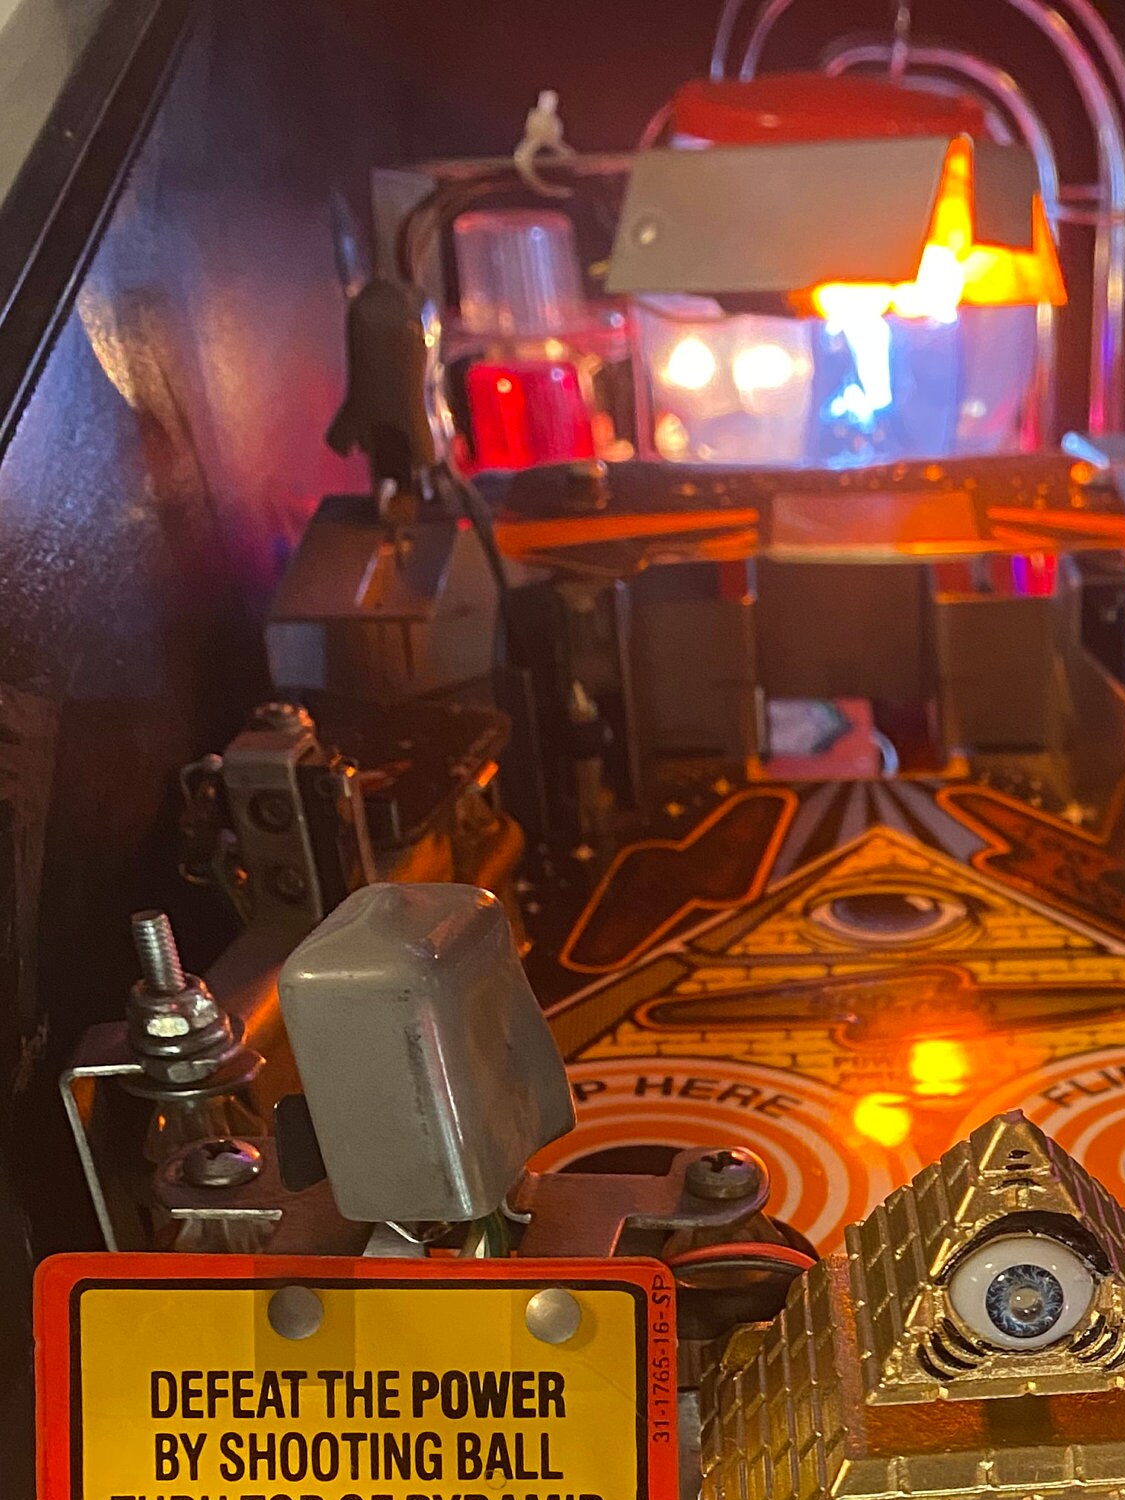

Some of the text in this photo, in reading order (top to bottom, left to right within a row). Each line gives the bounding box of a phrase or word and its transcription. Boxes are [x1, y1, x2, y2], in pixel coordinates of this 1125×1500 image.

[633, 1075, 803, 1120] HERE
[150, 1369, 567, 1419] DEFEAT THE POWER
[154, 1432, 564, 1482] BY SHOOTING BALL
